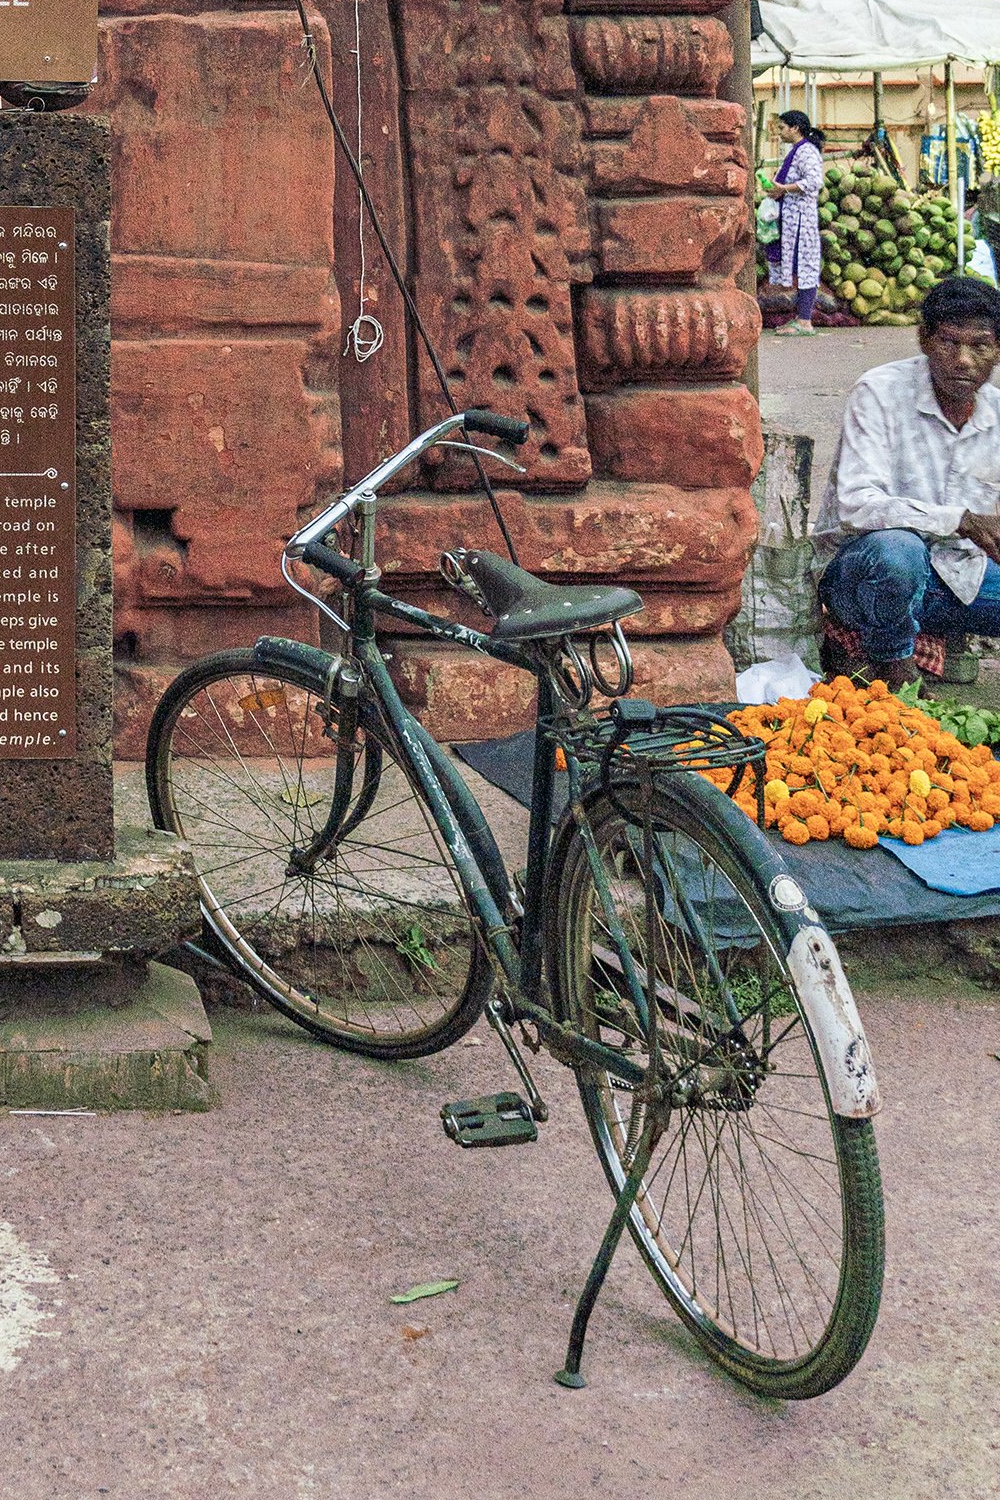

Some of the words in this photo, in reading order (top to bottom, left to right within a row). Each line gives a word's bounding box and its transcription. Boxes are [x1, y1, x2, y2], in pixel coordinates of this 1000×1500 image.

[12, 222, 57, 239] ମନ୍ଦିରର
[21, 248, 49, 264] ମିଳେ
[36, 274, 58, 291] ଏହି
[4, 351, 58, 368] ବିମାନରେ
[36, 376, 58, 394] ଏହି
[30, 403, 59, 420] କେହି
[4, 494, 57, 511] temple
[35, 521, 55, 532] on
[15, 541, 57, 556] after
[28, 565, 59, 580] and
[47, 589, 59, 603] is
[28, 612, 58, 630] give
[8, 637, 59, 653] temple
[2, 660, 33, 675] and
[40, 660, 60, 675] its
[29, 684, 60, 698] also
[13, 708, 59, 722] hence
